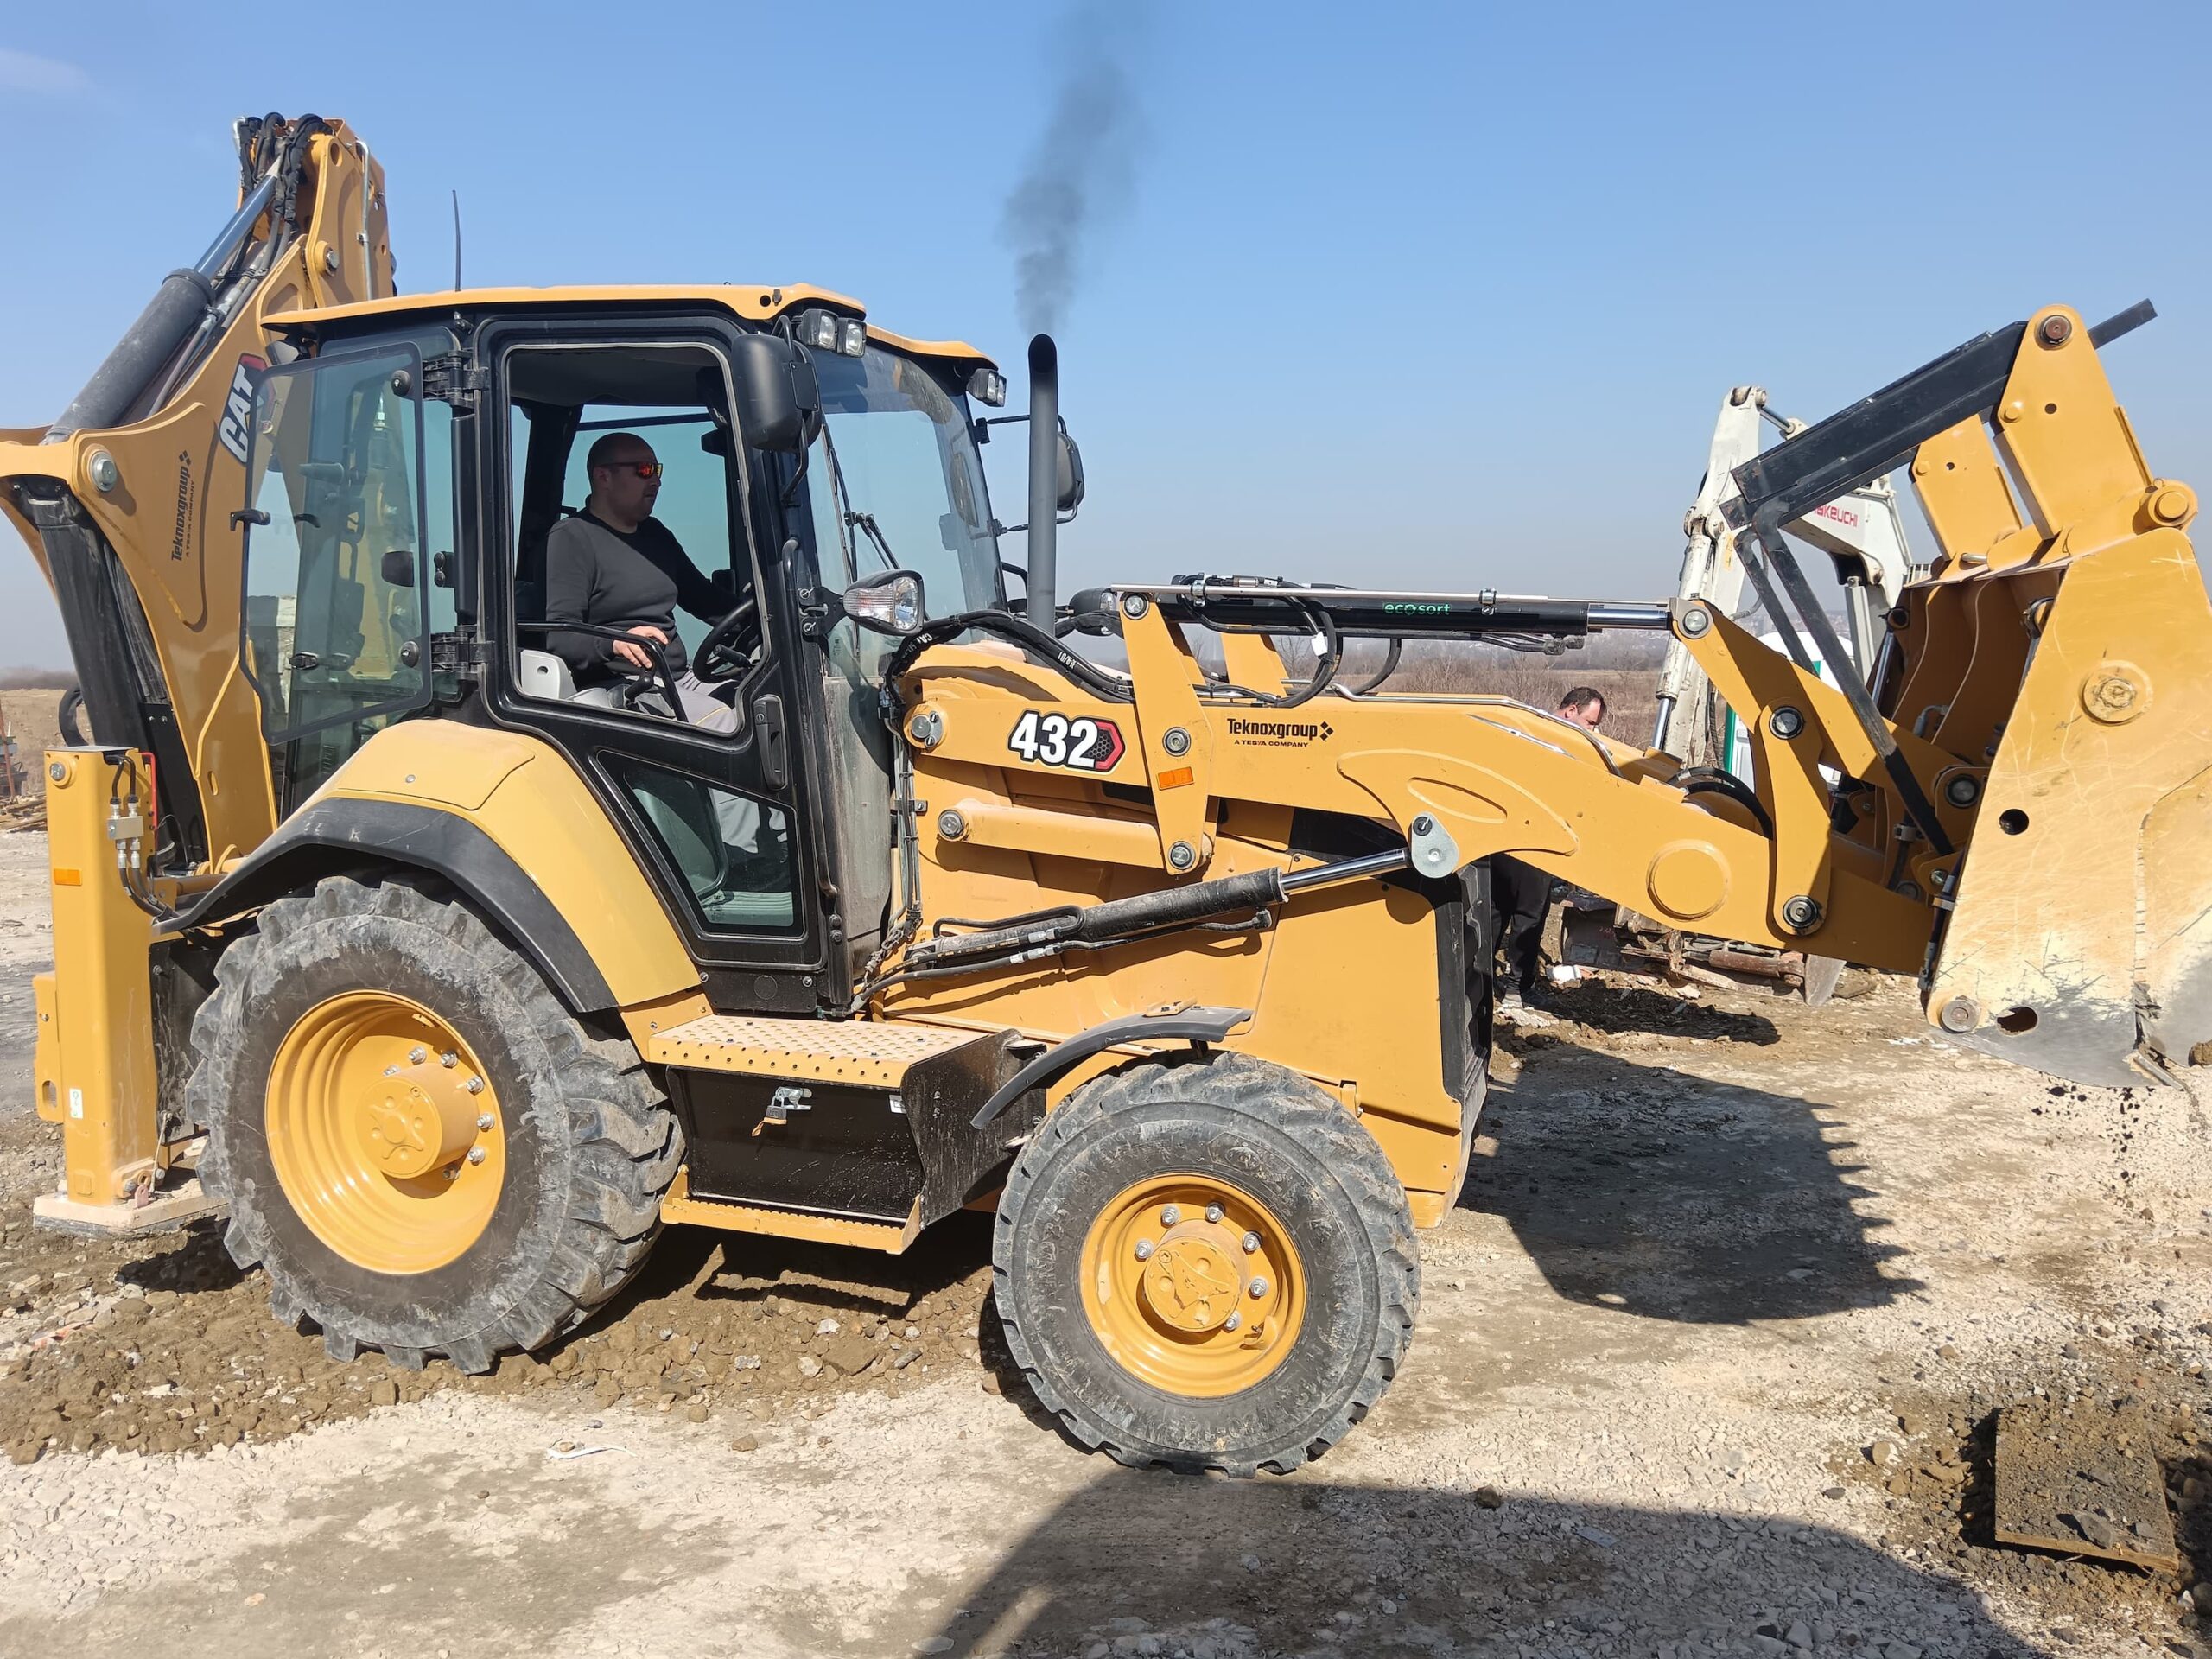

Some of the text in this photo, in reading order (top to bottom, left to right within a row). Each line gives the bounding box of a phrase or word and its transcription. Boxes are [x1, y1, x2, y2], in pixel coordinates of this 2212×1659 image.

[219, 364, 254, 464] CAT
[171, 466, 190, 562] Teknoxgroup
[1815, 505, 1858, 527] AKEUCHI
[1384, 603, 1451, 615] ecosort
[1010, 712, 1099, 768] 432
[1227, 718, 1318, 741] Teknoxgroup
